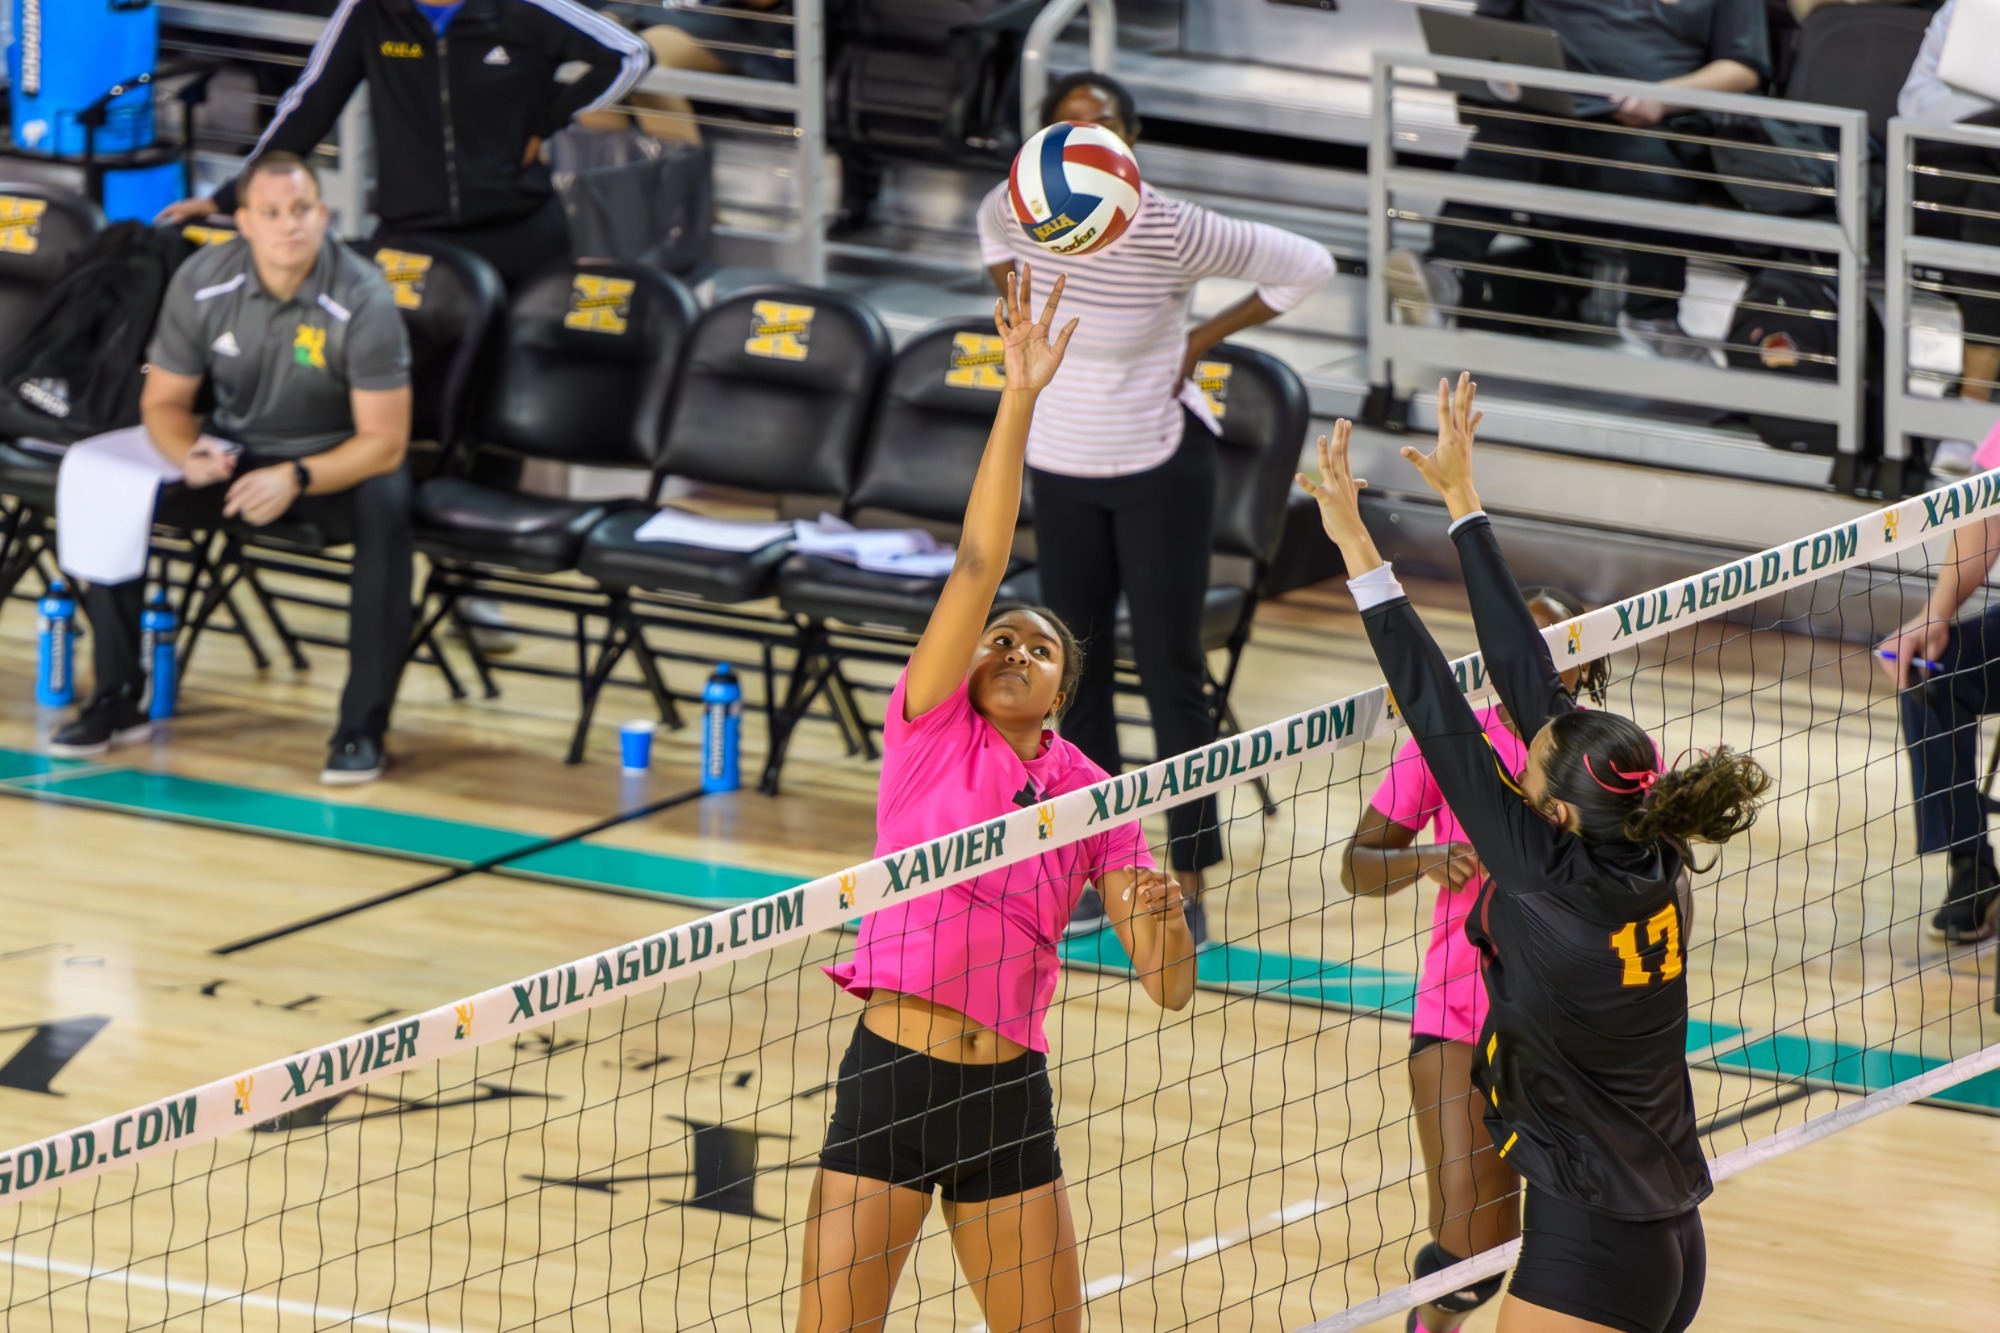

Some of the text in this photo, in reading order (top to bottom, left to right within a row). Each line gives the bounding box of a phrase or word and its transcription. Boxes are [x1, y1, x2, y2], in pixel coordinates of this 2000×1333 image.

[1032, 212, 1079, 242] NAIA
[280, 1019, 420, 1102] XAVIER
[507, 891, 804, 1023] XULAGOLD.COM
[882, 819, 1006, 898] XAVIER
[1086, 698, 1355, 826] XULAGOLD.COM
[1612, 523, 1858, 641] XULAGOLD.COM
[1609, 901, 1682, 987] 17
